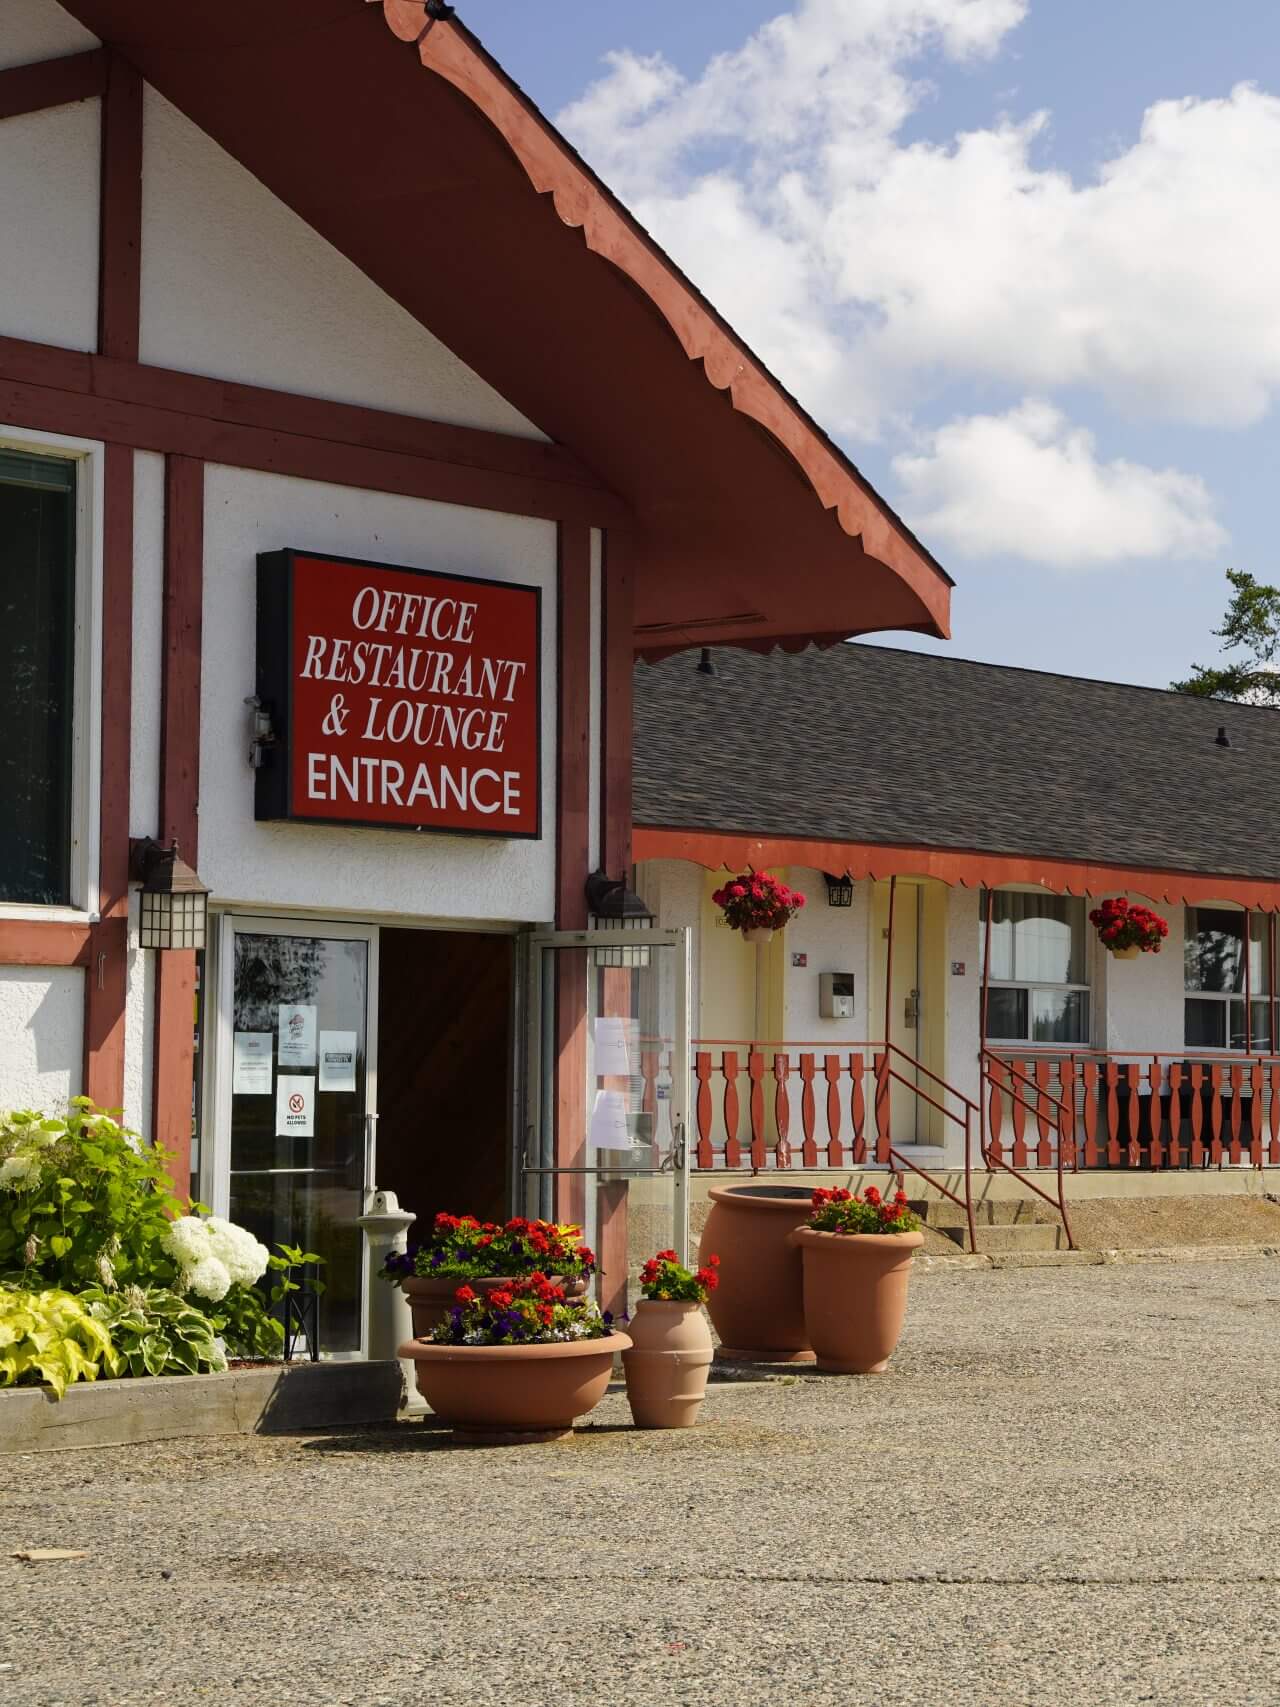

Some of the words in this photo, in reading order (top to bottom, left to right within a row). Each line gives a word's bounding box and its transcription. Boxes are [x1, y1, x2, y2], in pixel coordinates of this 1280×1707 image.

[353, 586, 478, 644] OFFICE
[299, 635, 526, 702] RESTAURANT
[321, 693, 350, 737] &
[361, 697, 508, 753] LOUNGE
[308, 752, 521, 816] ENTRANCE
